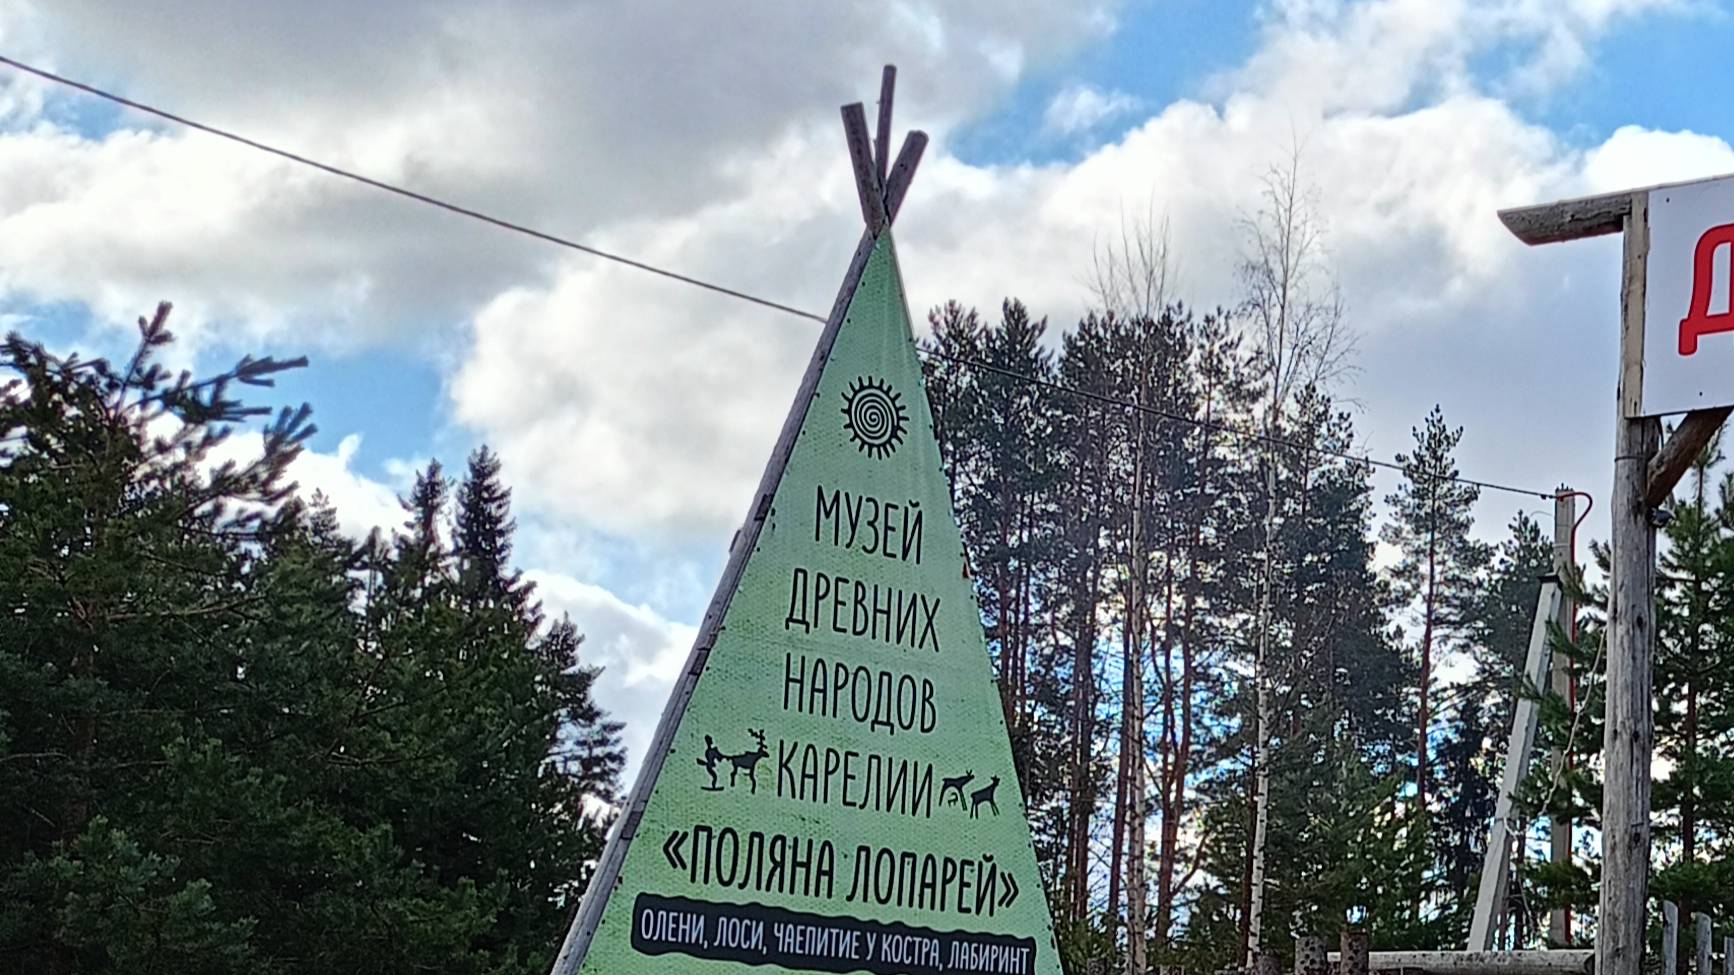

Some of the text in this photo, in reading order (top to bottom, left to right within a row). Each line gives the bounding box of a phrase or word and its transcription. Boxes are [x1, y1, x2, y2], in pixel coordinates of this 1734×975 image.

[814, 485, 923, 565] МУЗЕЙ
[785, 568, 941, 653] ДРЕВНИХ
[783, 653, 937, 735] НАРОДОВ
[777, 739, 934, 819] КАРЕЛИИ
[662, 824, 1020, 917] «ПОЛЯНА ЛОПАРЕЙ»
[641, 908, 1031, 975] ОЛЕНИ, ЛОСИ, ЧАЕПИТИЕ У КОСТРА, ЛАБИРИНТ
